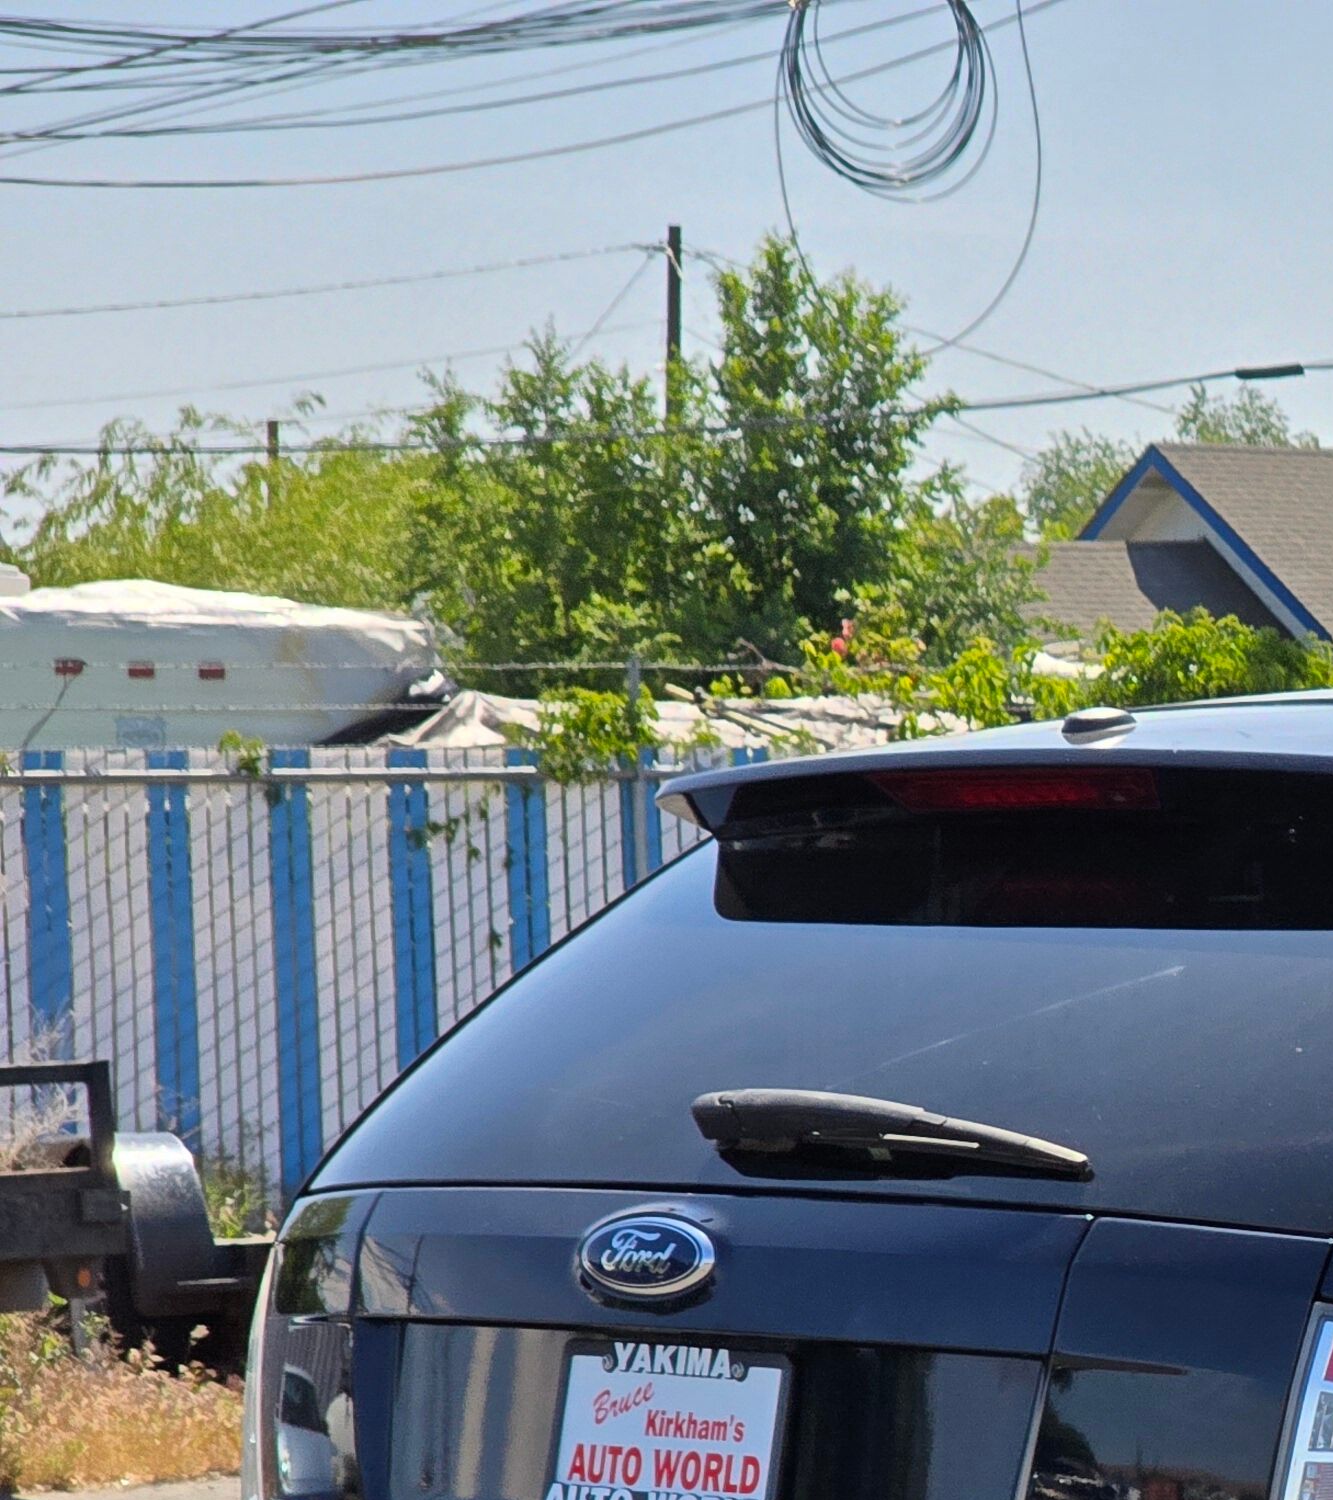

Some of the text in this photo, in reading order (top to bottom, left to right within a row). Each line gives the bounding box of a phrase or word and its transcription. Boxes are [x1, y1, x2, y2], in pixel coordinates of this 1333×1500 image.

[601, 1228, 678, 1275] Ford
[614, 1341, 733, 1379] YAKIMA
[593, 1382, 655, 1424] Bruce
[644, 1409, 745, 1443] Kirkham's
[567, 1443, 761, 1494] AUTO WORLD
